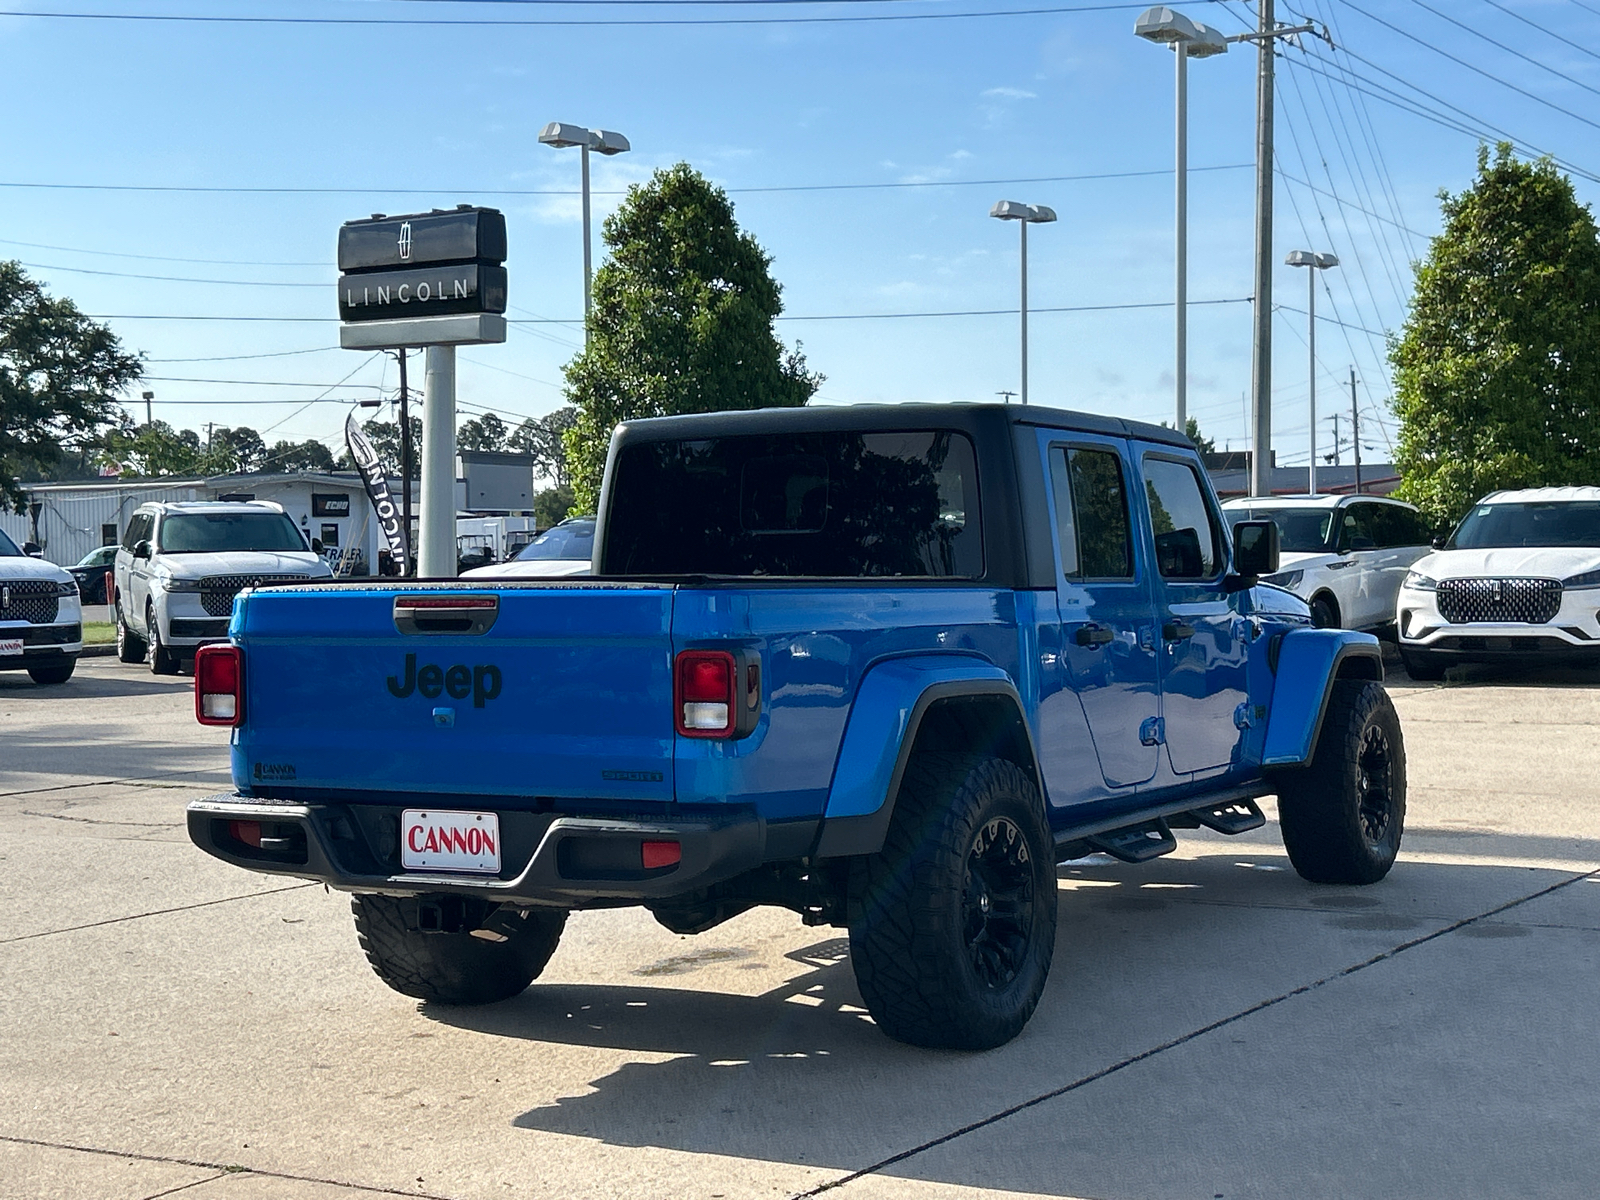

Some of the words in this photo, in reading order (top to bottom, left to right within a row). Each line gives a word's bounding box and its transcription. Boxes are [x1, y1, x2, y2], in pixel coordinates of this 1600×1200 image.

[347, 279, 467, 308] LINCOLN
[387, 653, 502, 708] Jeep
[602, 770, 663, 781] SPORT
[408, 825, 495, 856] CANNON
